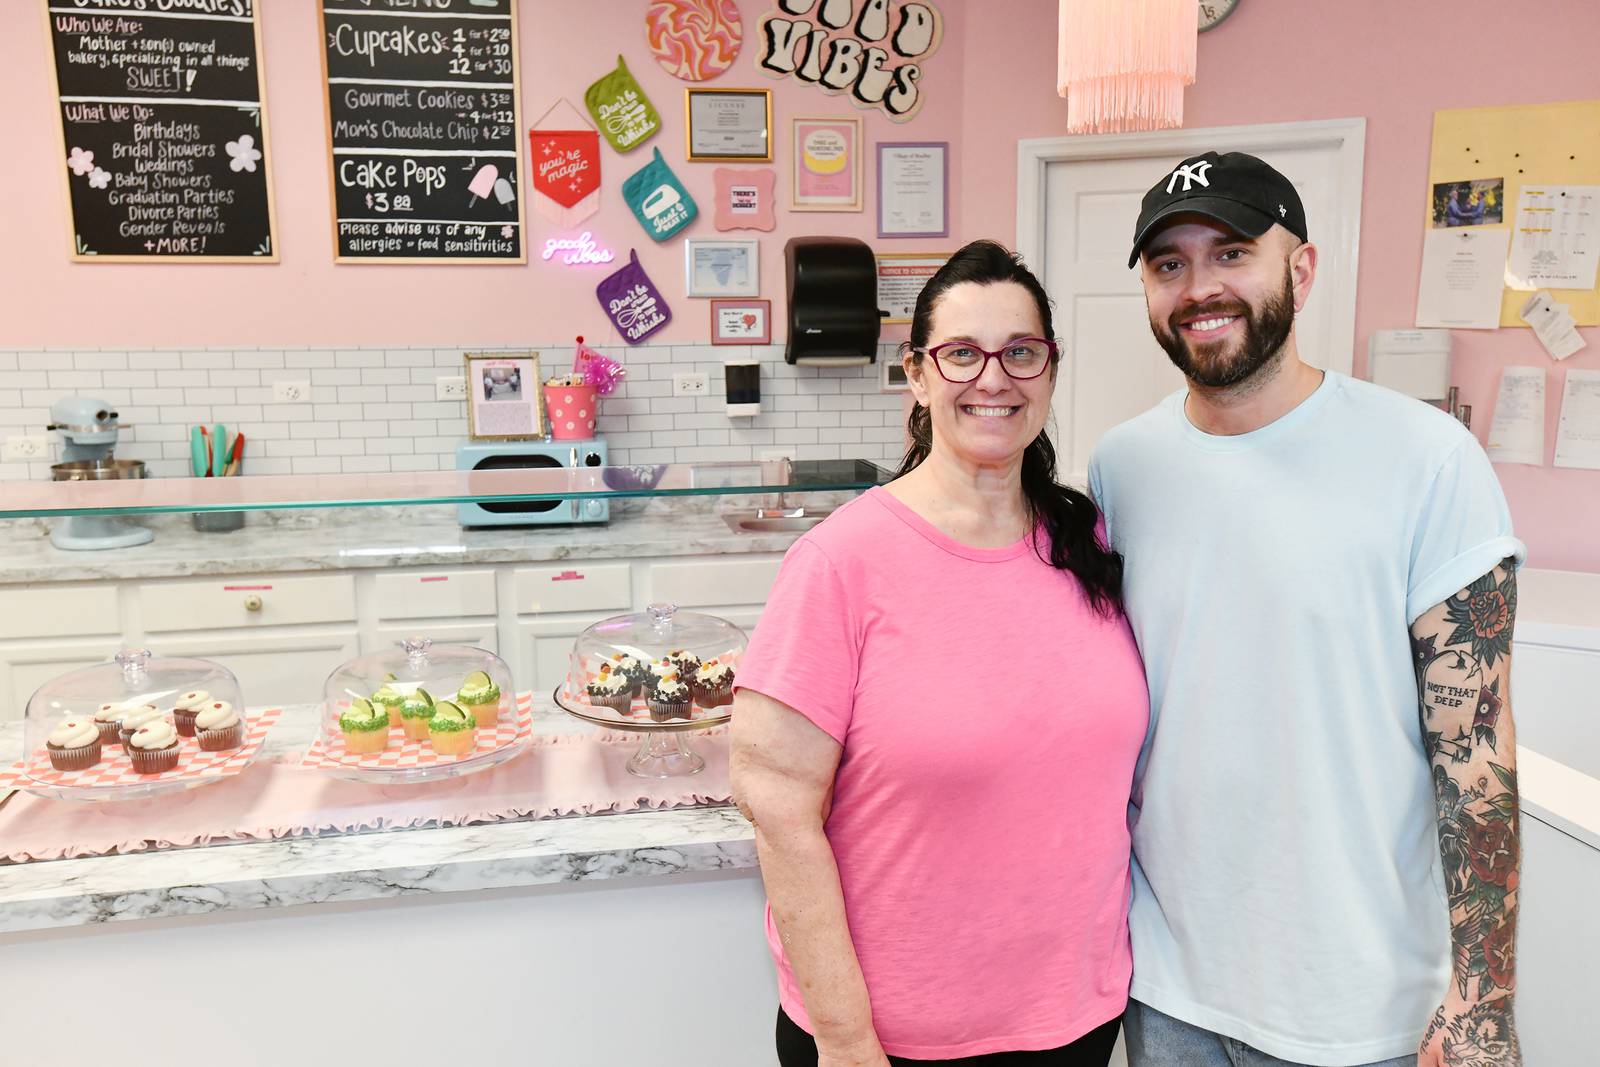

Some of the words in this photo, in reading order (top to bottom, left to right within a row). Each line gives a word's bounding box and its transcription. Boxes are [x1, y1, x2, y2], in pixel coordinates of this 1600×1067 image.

[56, 16, 90, 32] Who
[92, 17, 113, 33] We
[116, 18, 143, 33] Are:
[778, 0, 934, 57] OOD
[80, 36, 127, 51] Mother
[178, 39, 215, 53] owned
[335, 23, 443, 67] Cupcakes
[453, 28, 466, 42] 1
[469, 29, 482, 39] for
[452, 44, 466, 58] 4
[470, 46, 483, 56] for
[486, 43, 510, 56] $10
[68, 50, 110, 68] bakery,
[112, 51, 181, 71] specializing
[186, 54, 198, 66] in
[201, 54, 213, 66] all
[216, 54, 250, 71] things
[449, 58, 472, 75] 12
[475, 60, 488, 71] for
[488, 59, 511, 75] $30
[762, 18, 921, 114] VIBES
[345, 89, 412, 109] Gourmet
[418, 90, 474, 110] Cookies
[65, 105, 106, 121] What
[109, 104, 130, 121] We
[133, 105, 154, 122] Do:
[469, 111, 481, 124] 4
[491, 110, 514, 123] $12
[133, 122, 200, 142] Birthdays
[334, 120, 377, 139] Mom's
[382, 120, 444, 140] Chocolate
[447, 121, 479, 143] Chip
[112, 142, 153, 159] Bridal
[158, 141, 216, 159] Showers
[135, 158, 194, 175] Weddings
[540, 149, 581, 177] you're
[547, 159, 589, 184] magic
[115, 173, 148, 192] Baby
[152, 172, 211, 189] Showers
[340, 160, 397, 189] Cake
[403, 159, 446, 196] Pops
[108, 190, 180, 205] Graduation
[184, 189, 235, 204] Parties
[365, 192, 389, 212] $3
[393, 194, 412, 209] ea
[128, 206, 175, 221] Divorce
[177, 205, 219, 221] Parties
[119, 221, 168, 237] Gender
[172, 221, 226, 235] Reveals
[340, 223, 380, 236] Please
[385, 222, 422, 236] advise
[427, 224, 441, 236] us
[446, 223, 460, 236] of
[464, 225, 486, 241] any
[349, 236, 402, 253] allergies
[417, 237, 439, 252] food
[444, 239, 513, 253] sensitivities
[542, 231, 592, 260] good
[563, 240, 615, 265] vibes
[609, 290, 638, 315] Don't
[635, 284, 649, 296] be
[1427, 682, 1447, 694] NOT
[1448, 686, 1477, 698] THAT
[1434, 695, 1463, 708] DEEP
